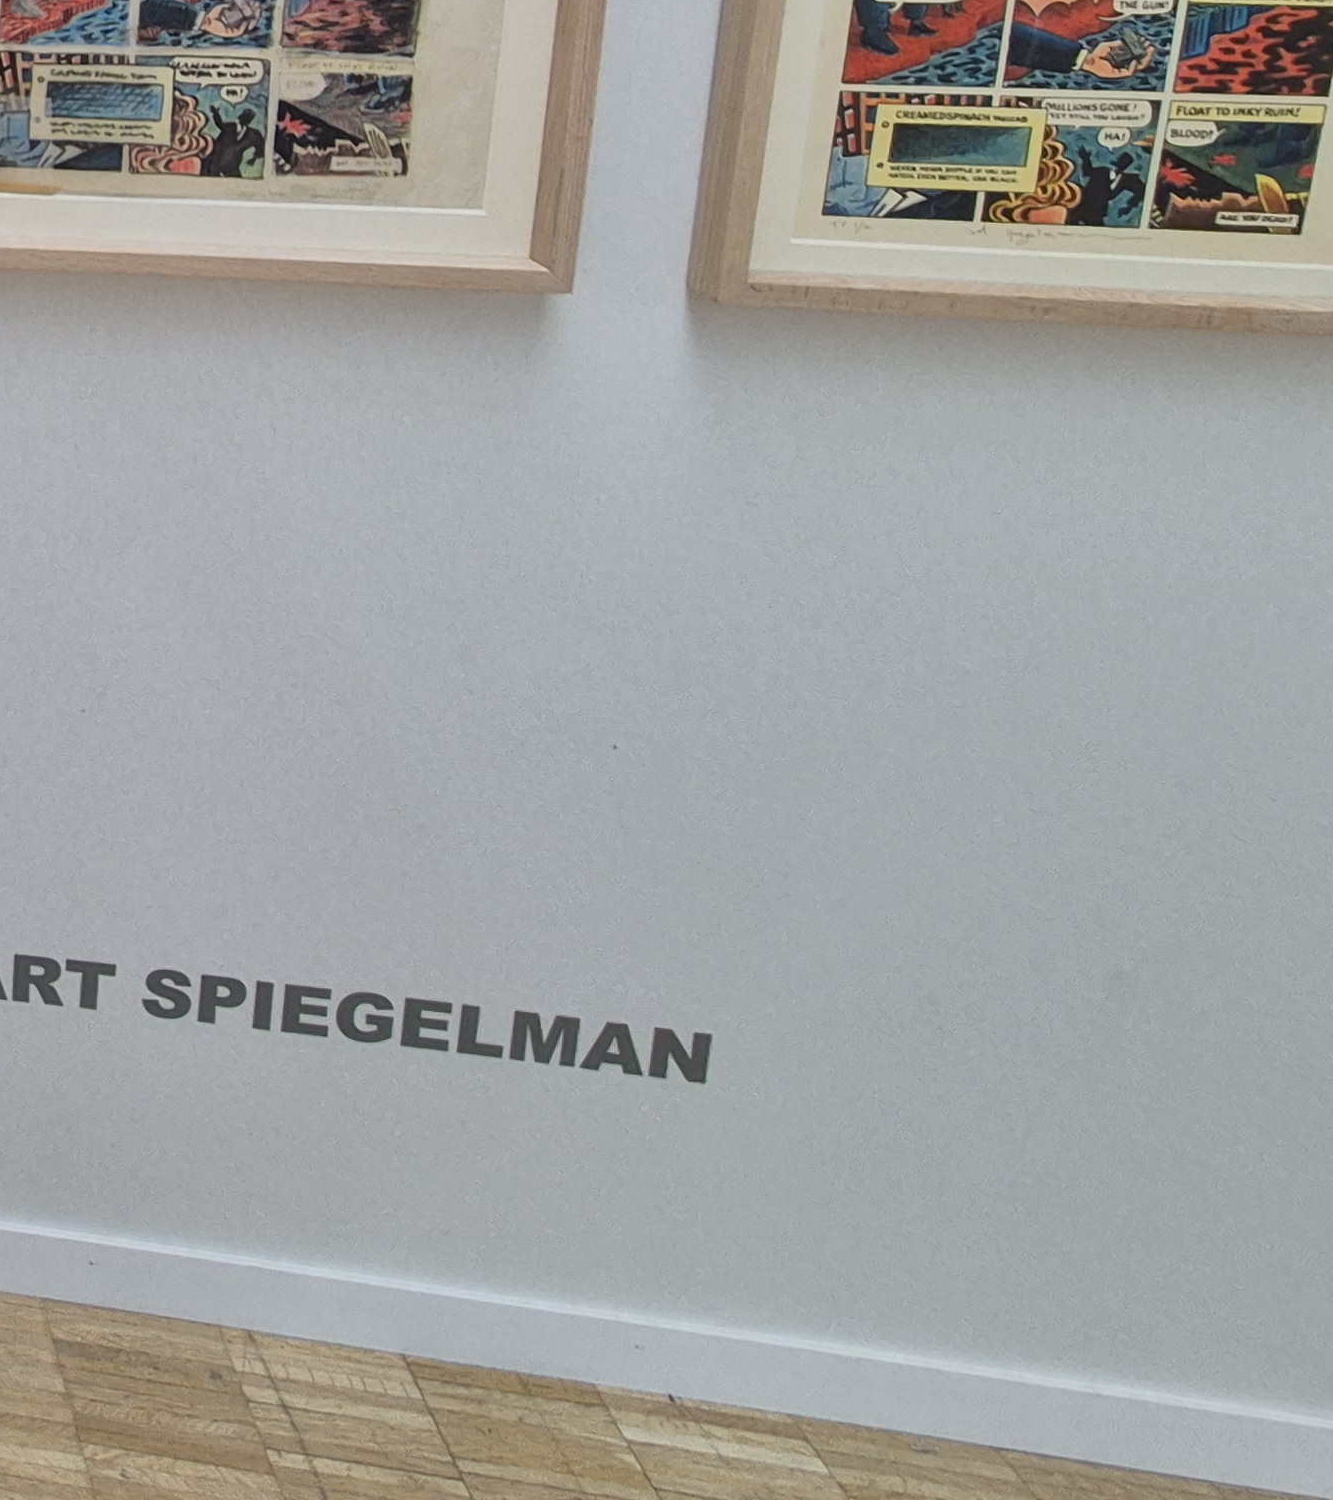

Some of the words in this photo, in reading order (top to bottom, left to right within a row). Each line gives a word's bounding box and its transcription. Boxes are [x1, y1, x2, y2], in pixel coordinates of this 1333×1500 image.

[1175, 105, 1213, 117] FLOAT
[1215, 106, 1231, 117] TO
[140, 968, 714, 1085] SPIEGELMAN
